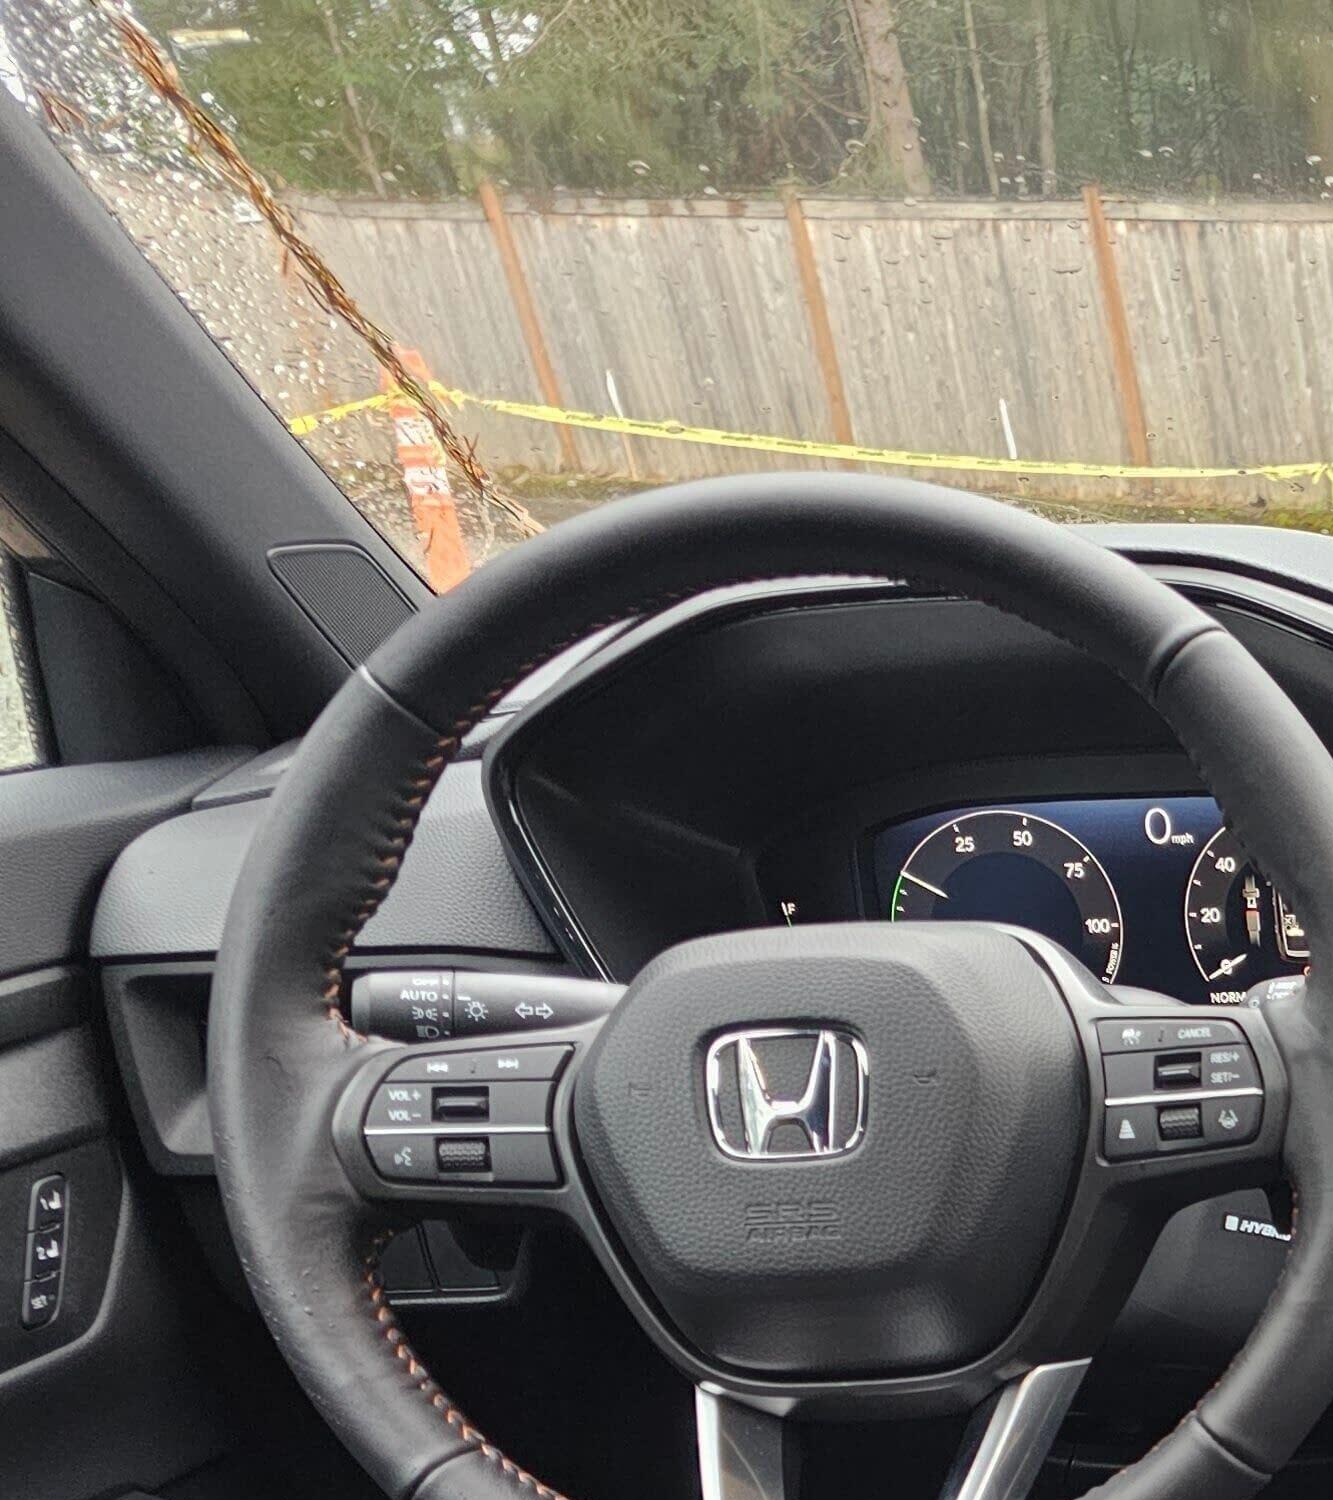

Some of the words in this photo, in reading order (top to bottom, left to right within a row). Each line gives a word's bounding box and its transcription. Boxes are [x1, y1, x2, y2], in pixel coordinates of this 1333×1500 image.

[1145, 807, 1171, 845] 0
[1171, 834, 1194, 846] mph
[955, 837, 975, 853] 25
[1013, 831, 1032, 847] 50
[1064, 863, 1084, 879] 75
[1215, 857, 1235, 873] 40
[1200, 907, 1220, 923] 20
[1085, 919, 1110, 934] 100
[401, 991, 438, 1001] AUTO
[1210, 991, 1247, 1003] NORM
[1178, 1028, 1211, 1039] CANCEL
[1240, 1219, 1292, 1241] HYB
